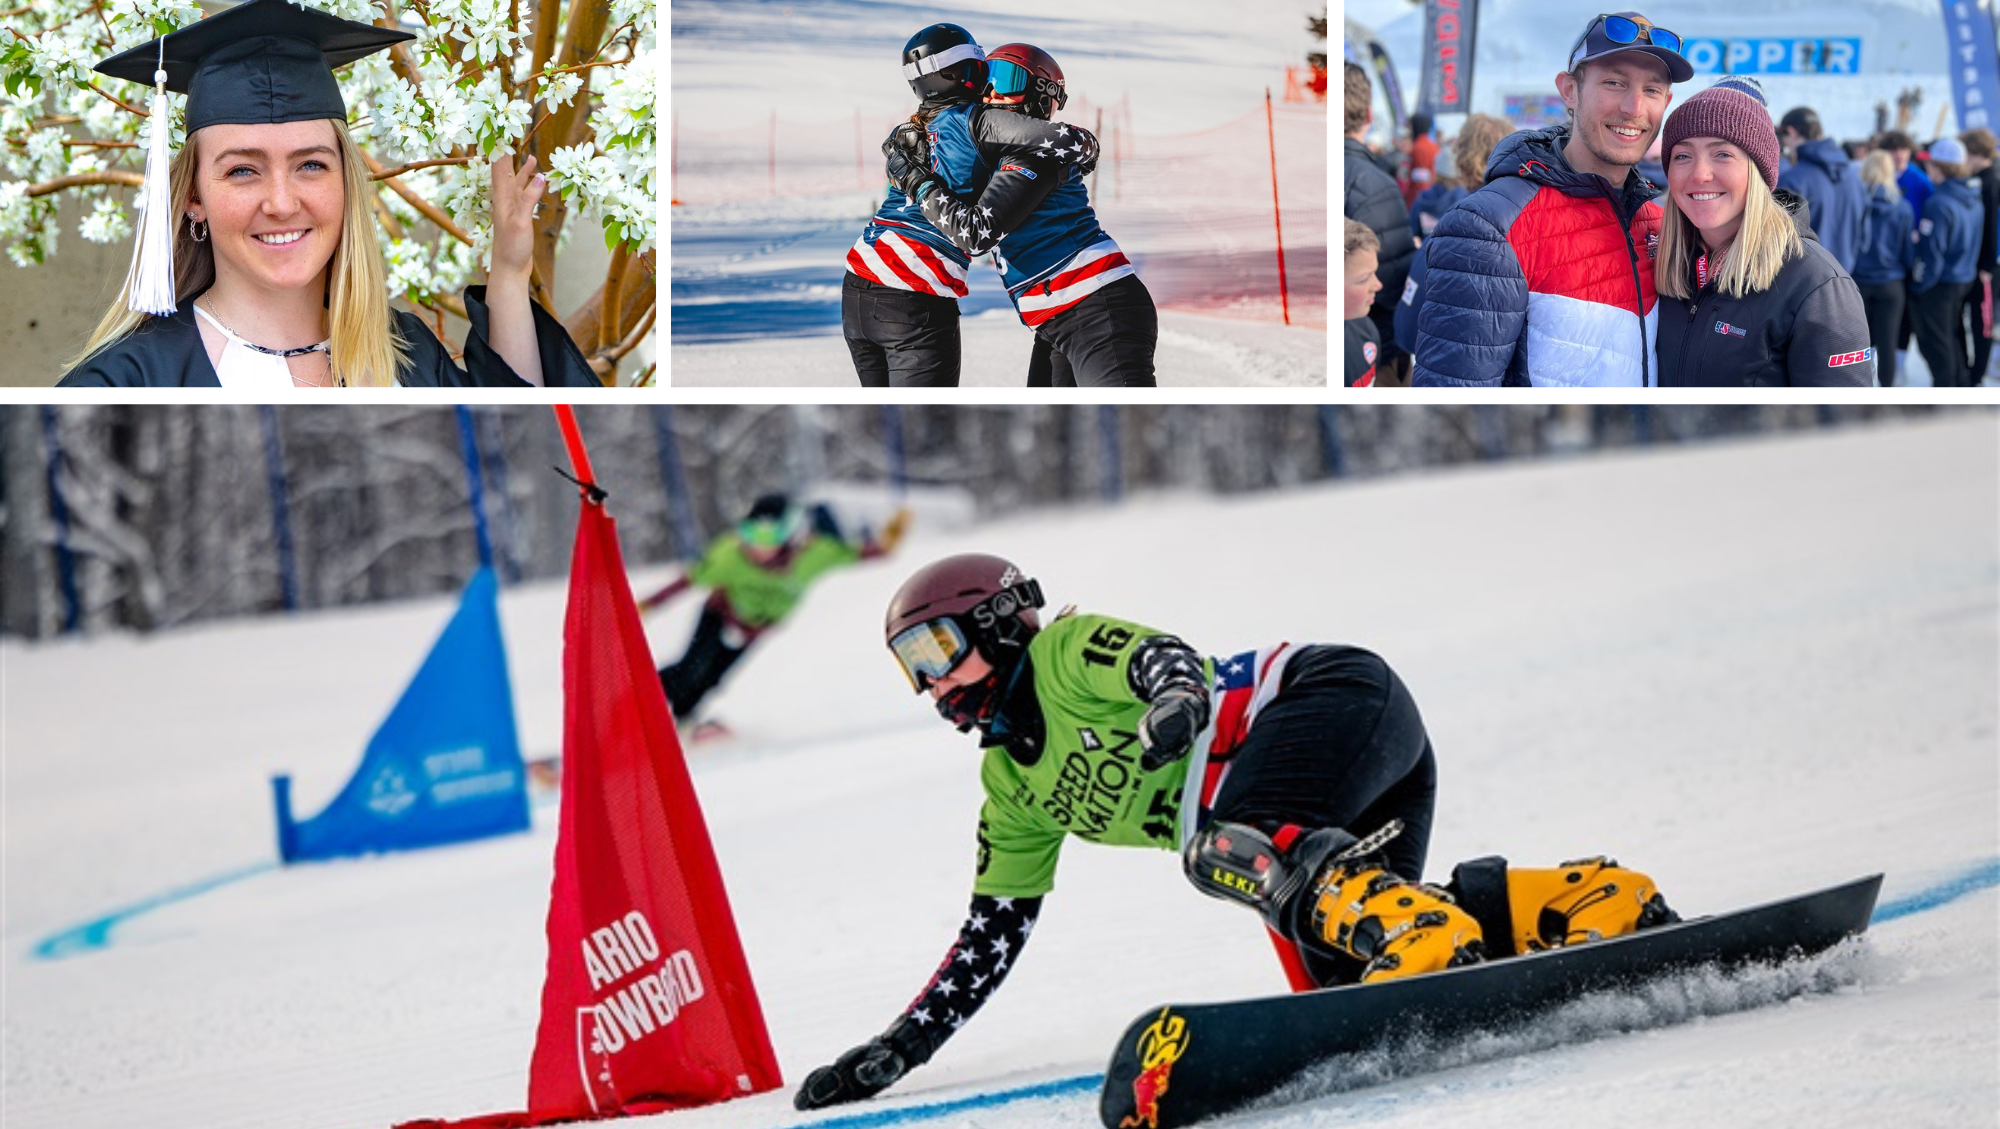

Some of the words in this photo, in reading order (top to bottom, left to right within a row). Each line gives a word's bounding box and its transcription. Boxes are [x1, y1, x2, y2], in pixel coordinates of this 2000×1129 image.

[1081, 622, 1135, 668] 15
[1043, 752, 1091, 826] SPEED
[1078, 728, 1138, 834] NATION
[1213, 866, 1256, 894] LEKI
[581, 910, 660, 991] ARIO
